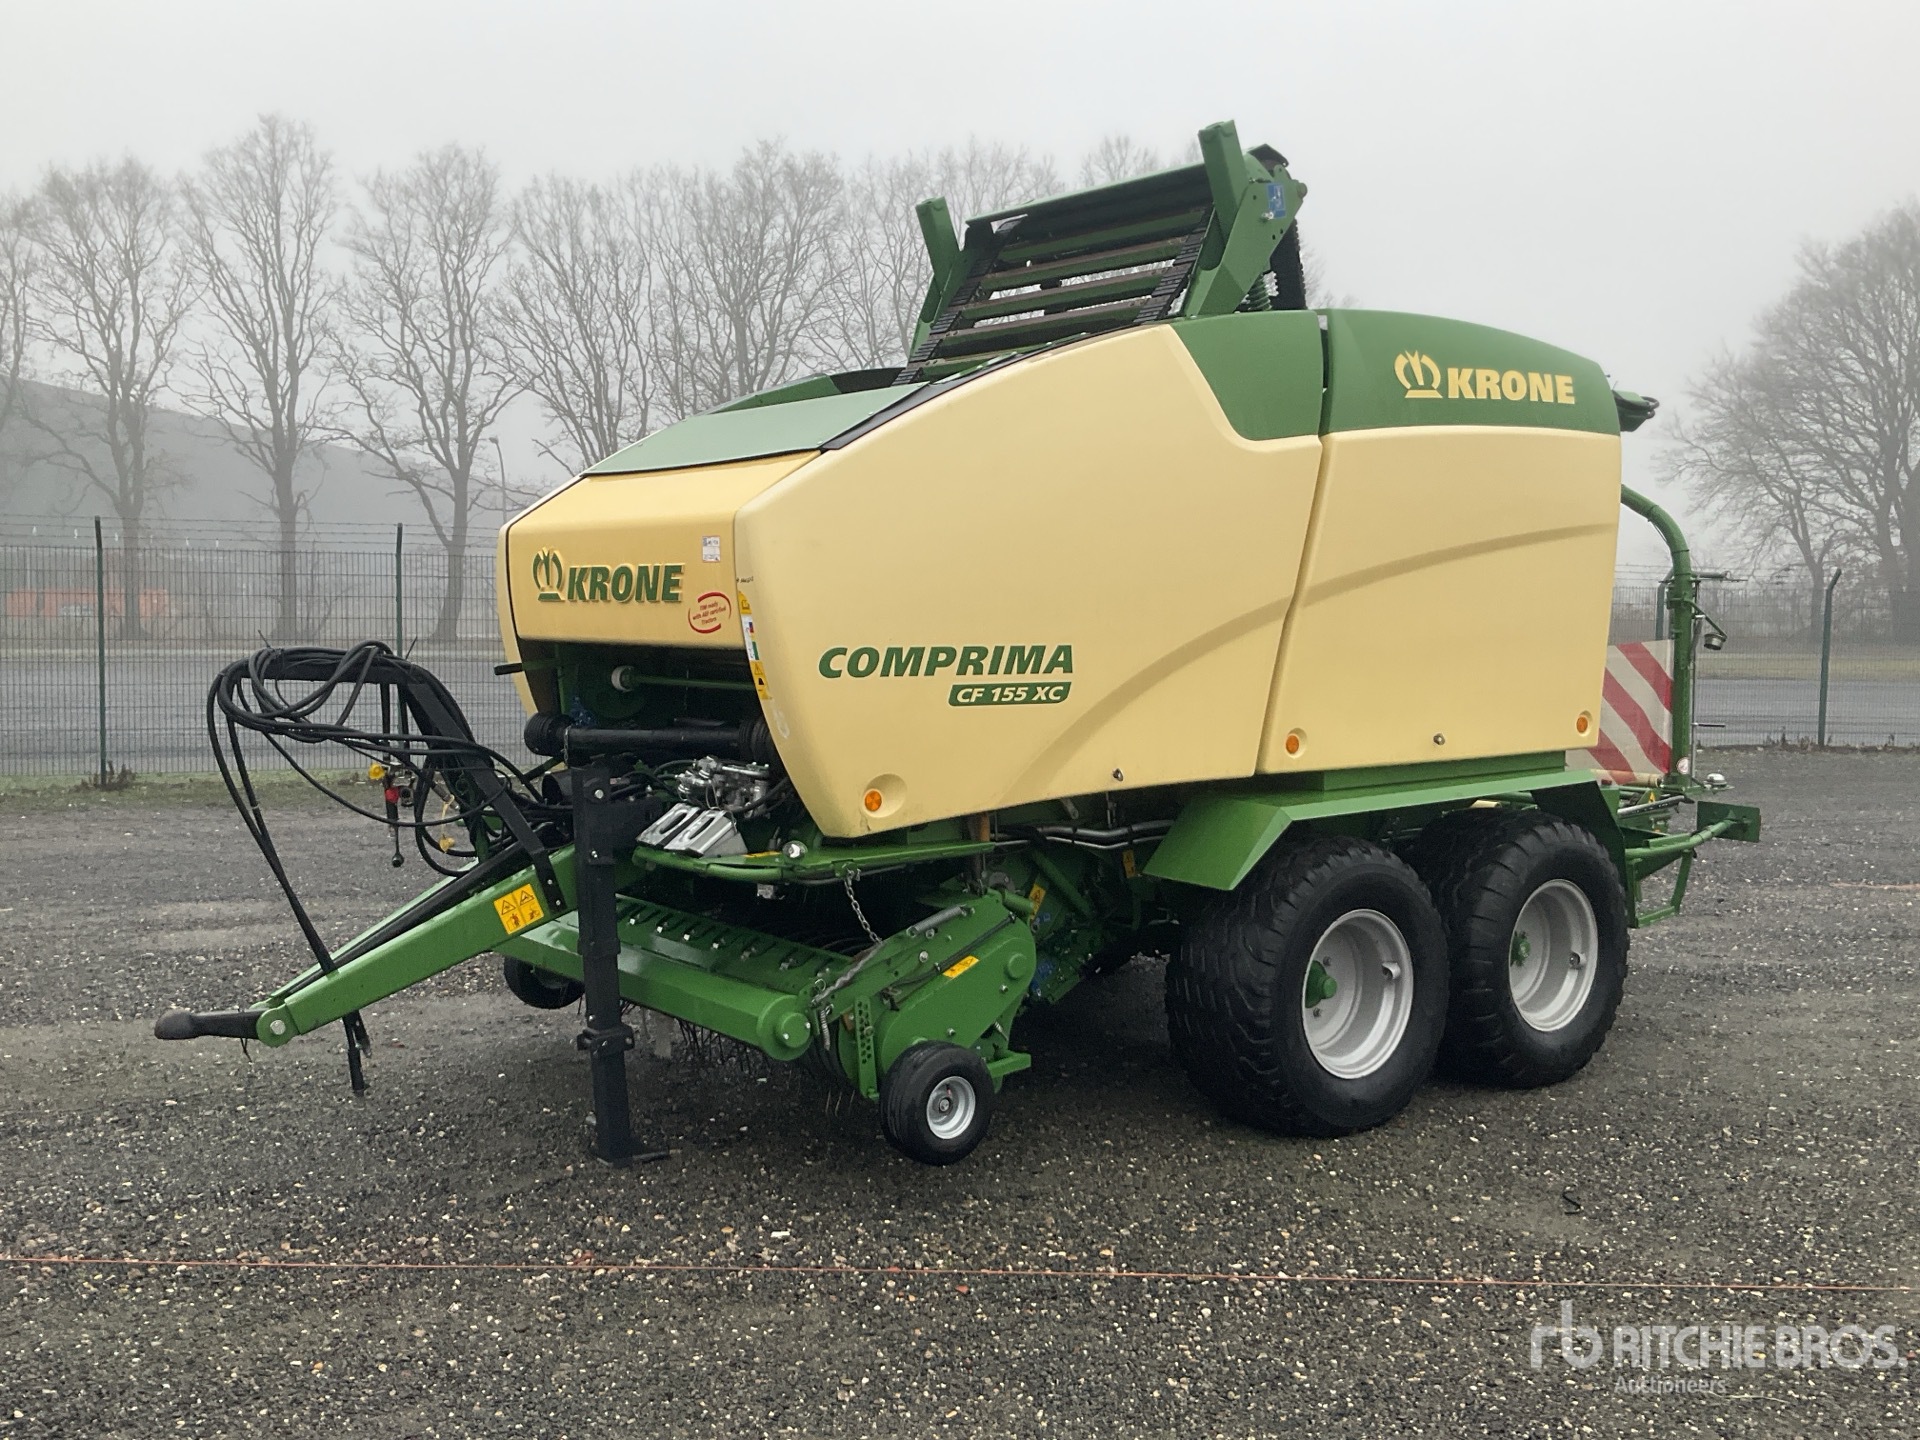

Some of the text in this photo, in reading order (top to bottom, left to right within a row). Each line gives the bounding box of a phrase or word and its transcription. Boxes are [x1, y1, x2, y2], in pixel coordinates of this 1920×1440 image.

[1447, 367, 1576, 405] KRONE
[566, 563, 685, 602] KRONE
[818, 644, 1074, 679] COMPRIMA
[956, 685, 1064, 703] CF 155 XC
